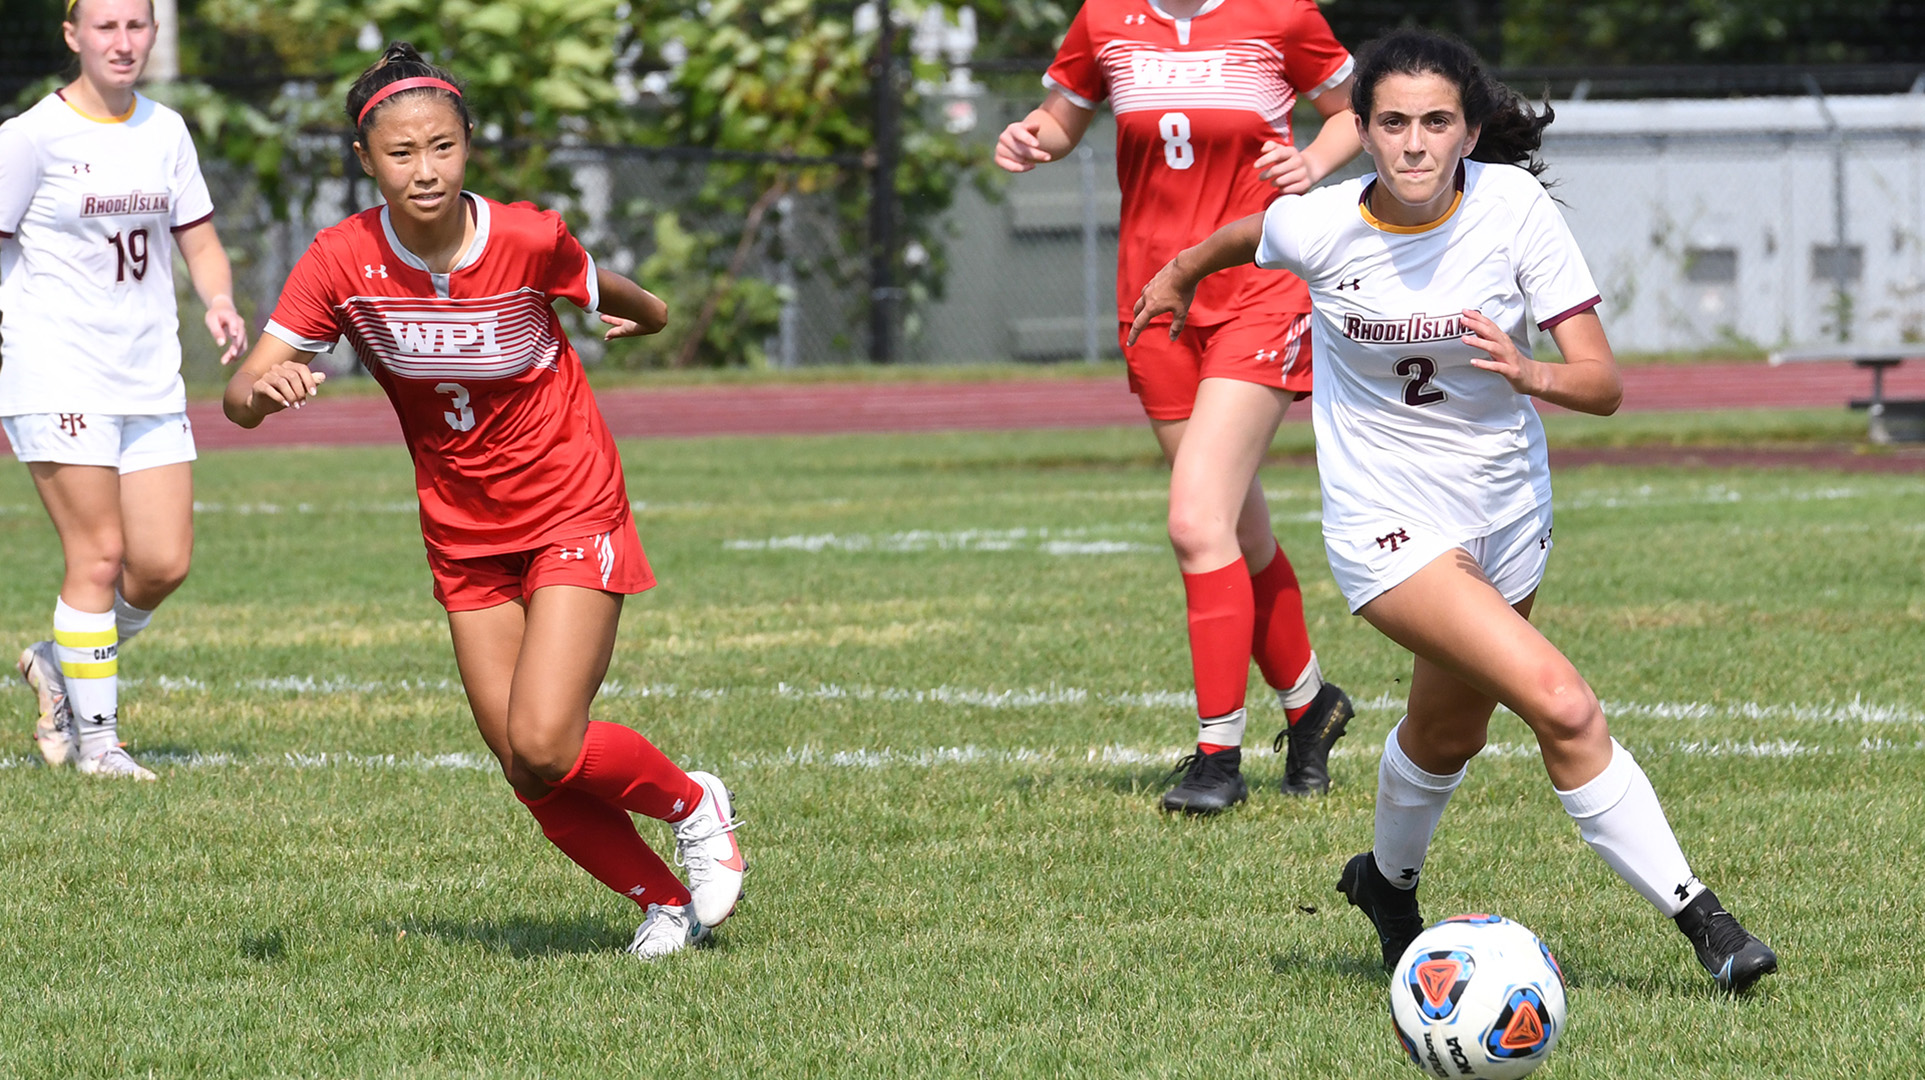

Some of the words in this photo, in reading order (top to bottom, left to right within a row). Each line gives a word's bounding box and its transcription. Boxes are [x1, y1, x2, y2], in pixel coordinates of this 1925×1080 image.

[1132, 58, 1226, 86] WPI
[1159, 112, 1195, 170] 8
[133, 193, 169, 211] ISLAN
[107, 228, 149, 282] 19
[386, 320, 501, 354] WPI
[1412, 316, 1475, 341] ISLAN
[1394, 356, 1446, 407] 2
[434, 382, 476, 432] 3
[1445, 1036, 1476, 1075] NCAA
